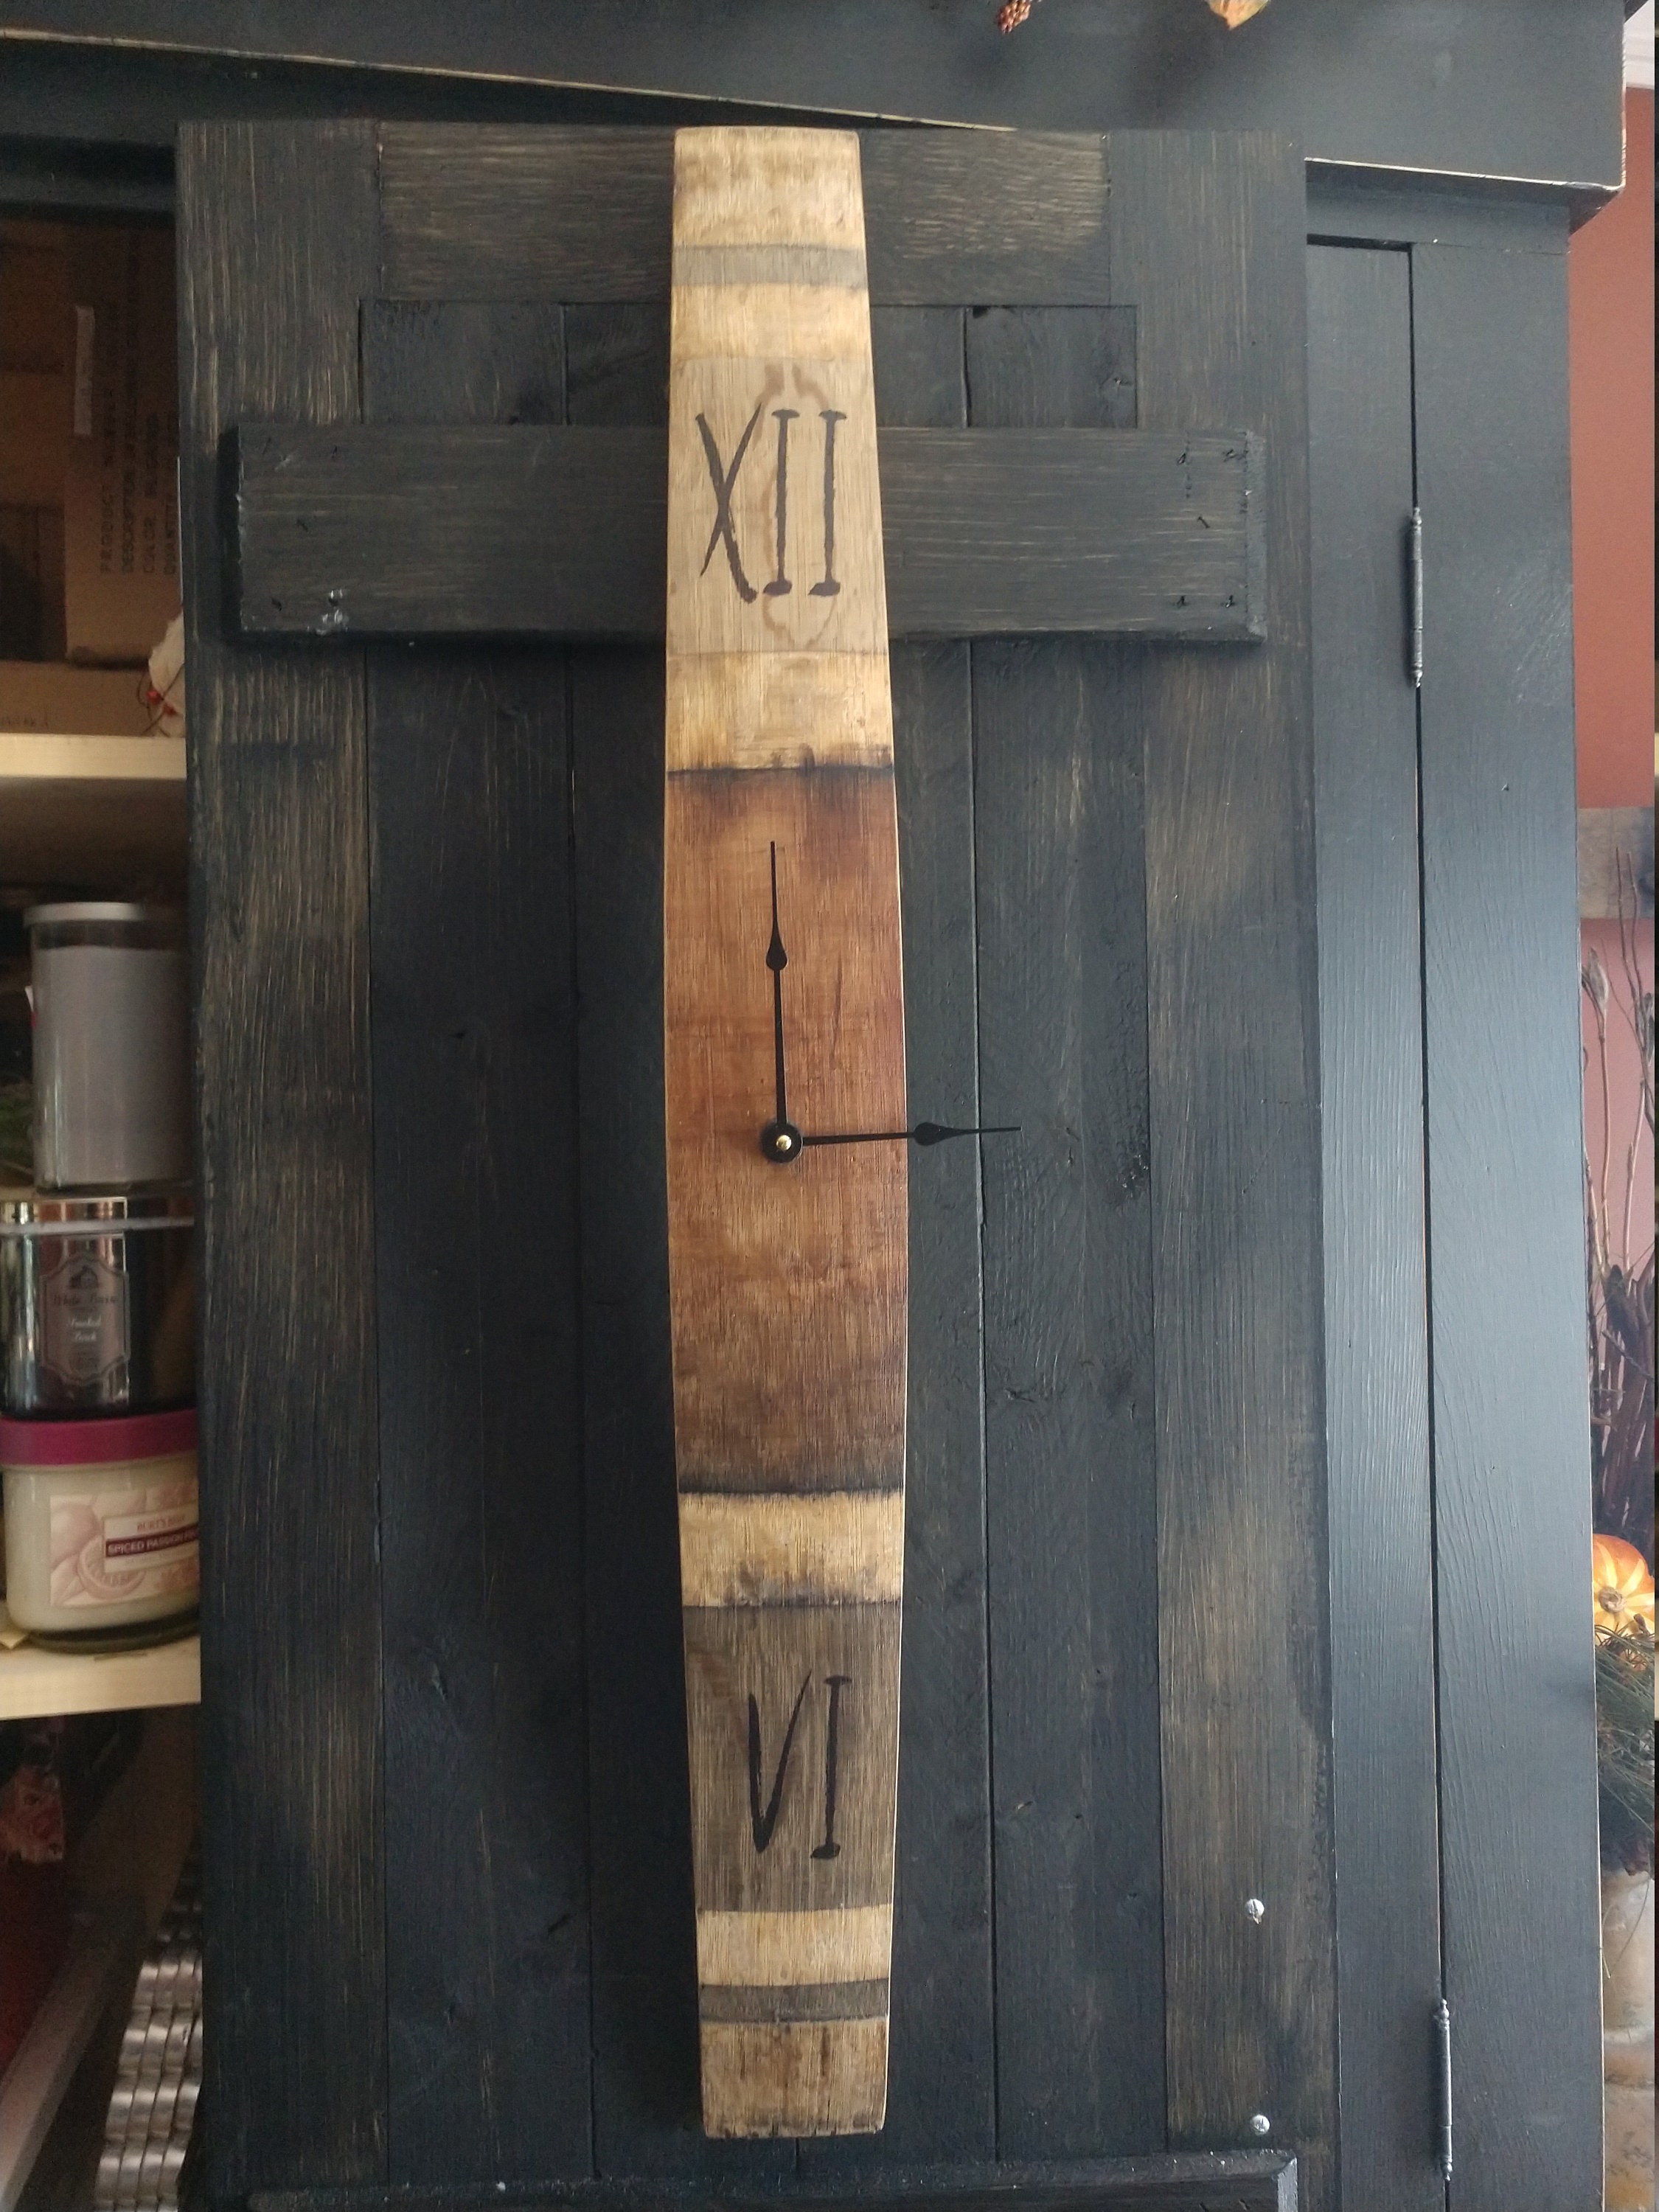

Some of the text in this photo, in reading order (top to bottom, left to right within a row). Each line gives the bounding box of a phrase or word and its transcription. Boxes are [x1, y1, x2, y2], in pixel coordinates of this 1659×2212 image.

[695, 403, 846, 603] XII
[108, 1540, 145, 1556] SPICED
[748, 1669, 852, 1859] VI
